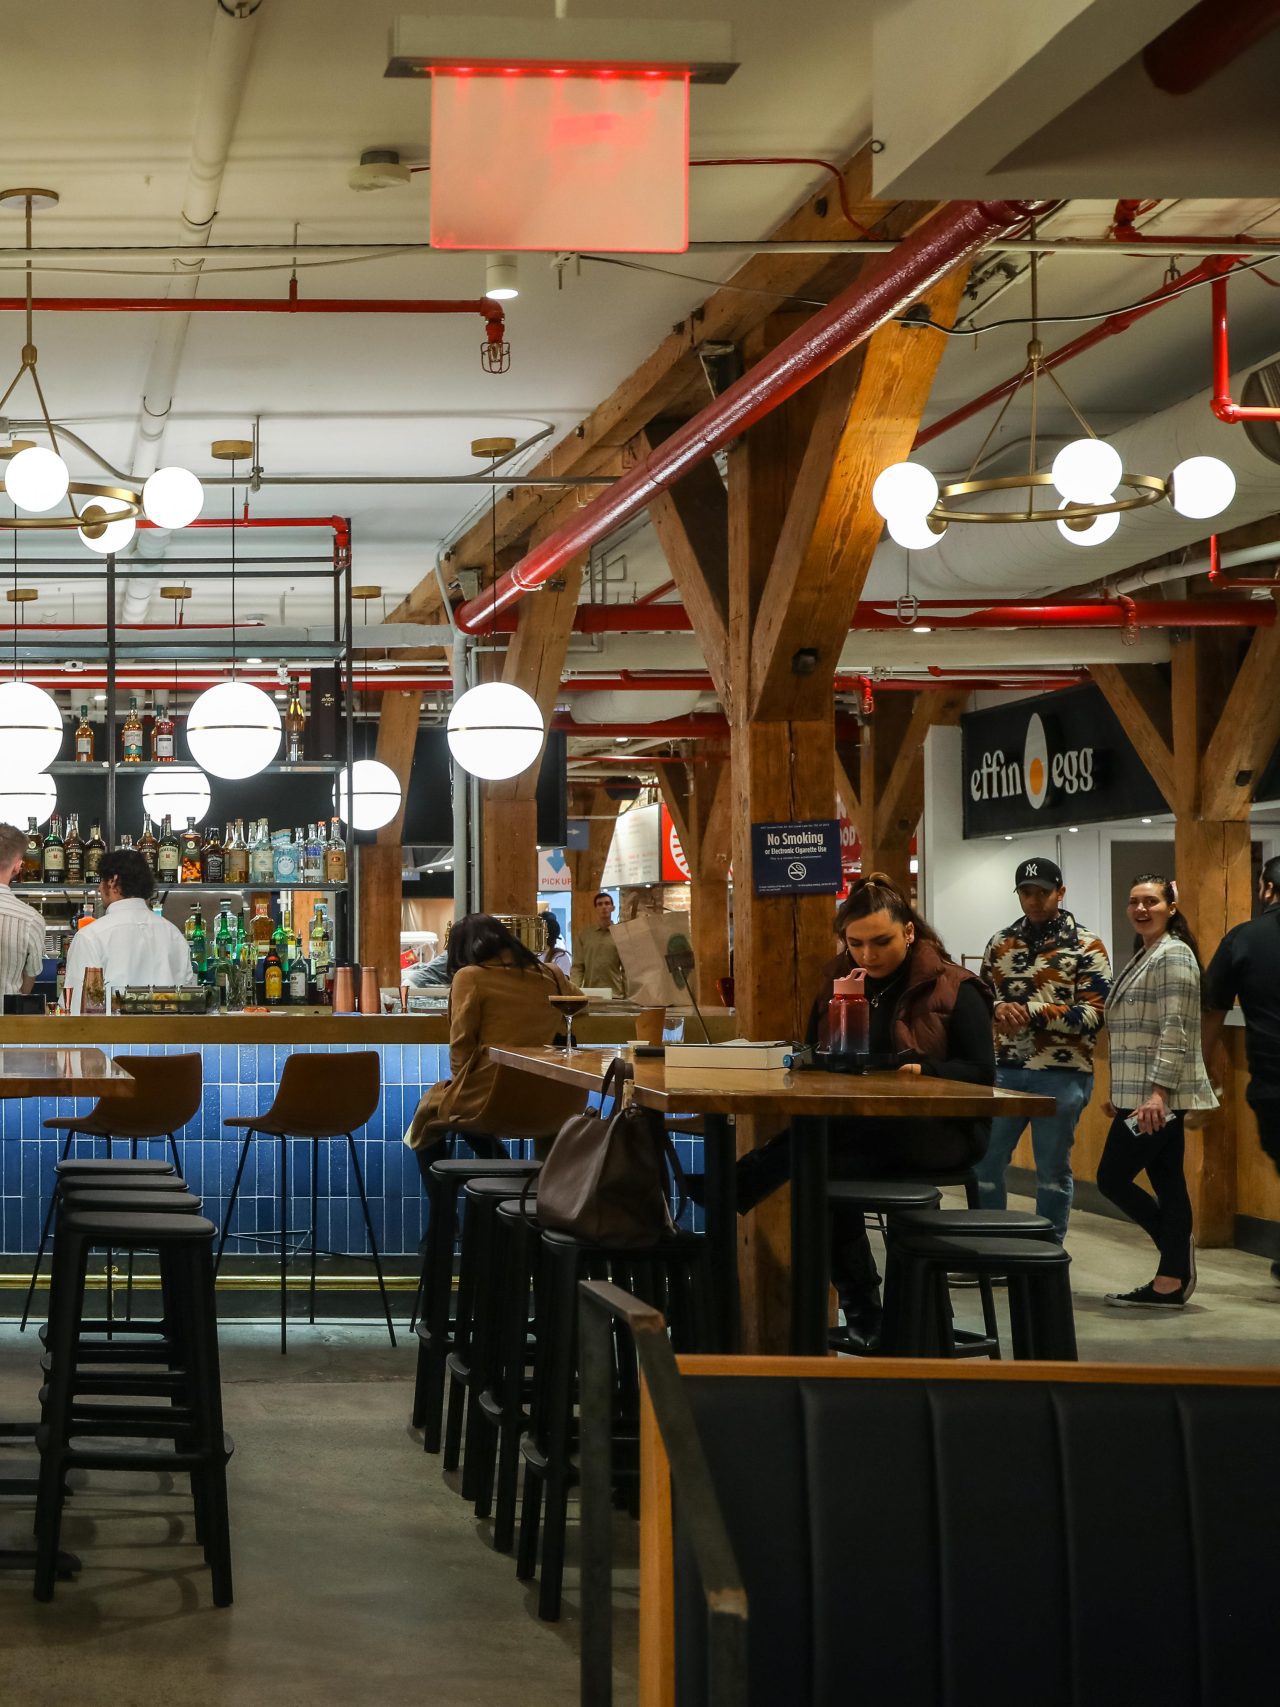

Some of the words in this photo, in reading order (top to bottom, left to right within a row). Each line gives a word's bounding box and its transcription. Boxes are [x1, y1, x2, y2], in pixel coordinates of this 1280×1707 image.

[970, 749, 1023, 802] effin
[1052, 747, 1094, 795] egg
[767, 833, 780, 846] No
[782, 831, 824, 846] Smoking
[771, 847, 794, 855] Electronic
[795, 846, 817, 854] Cigarette
[1025, 863, 1038, 877] NY
[541, 877, 560, 885] PICK
